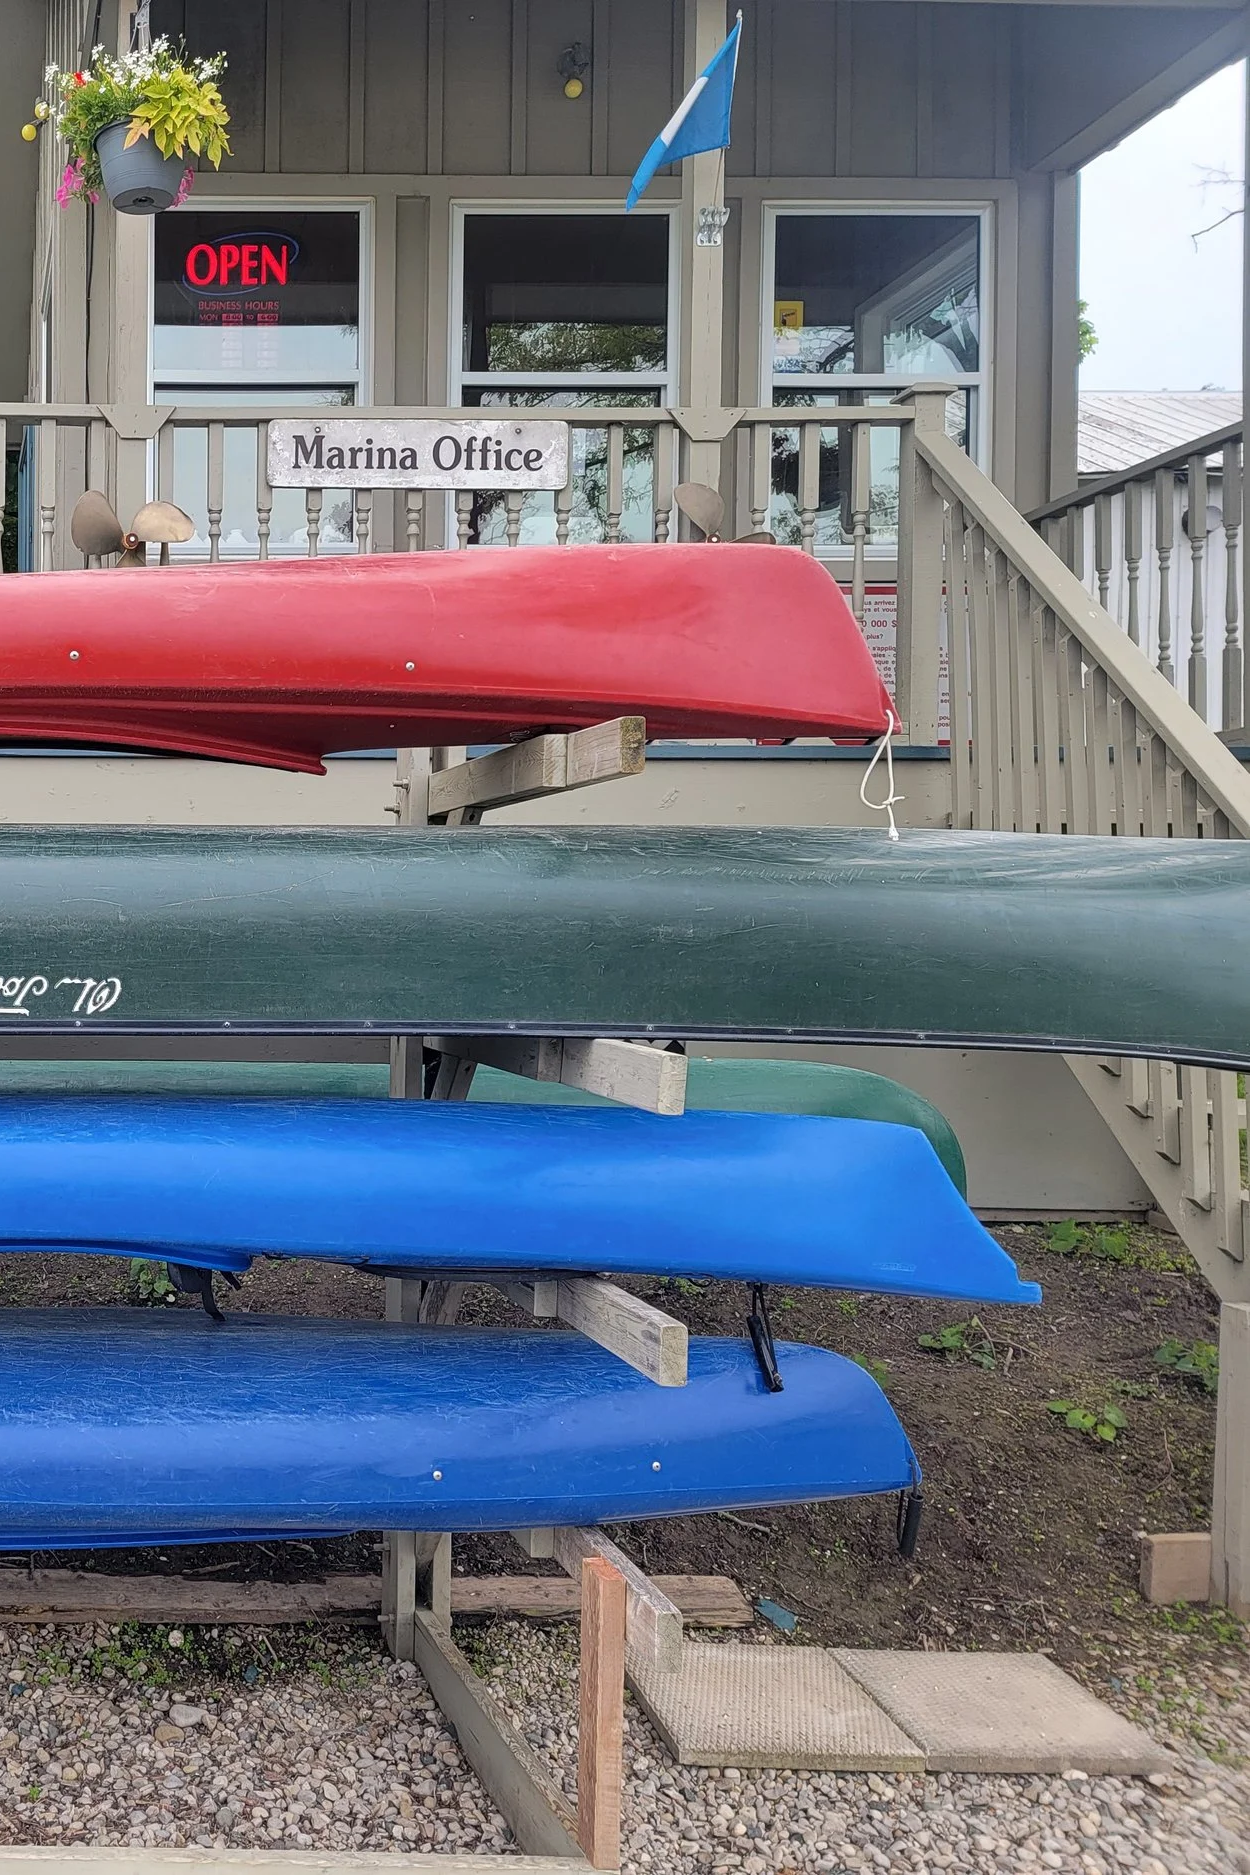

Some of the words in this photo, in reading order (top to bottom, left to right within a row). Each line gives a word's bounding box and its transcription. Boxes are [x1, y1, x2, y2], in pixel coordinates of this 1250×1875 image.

[185, 243, 288, 286] OPEN
[198, 301, 242, 310] BUSINESS
[245, 301, 280, 310] HOURS
[292, 434, 419, 470] Marina
[432, 435, 543, 471] Office
[870, 620, 888, 628] 000
